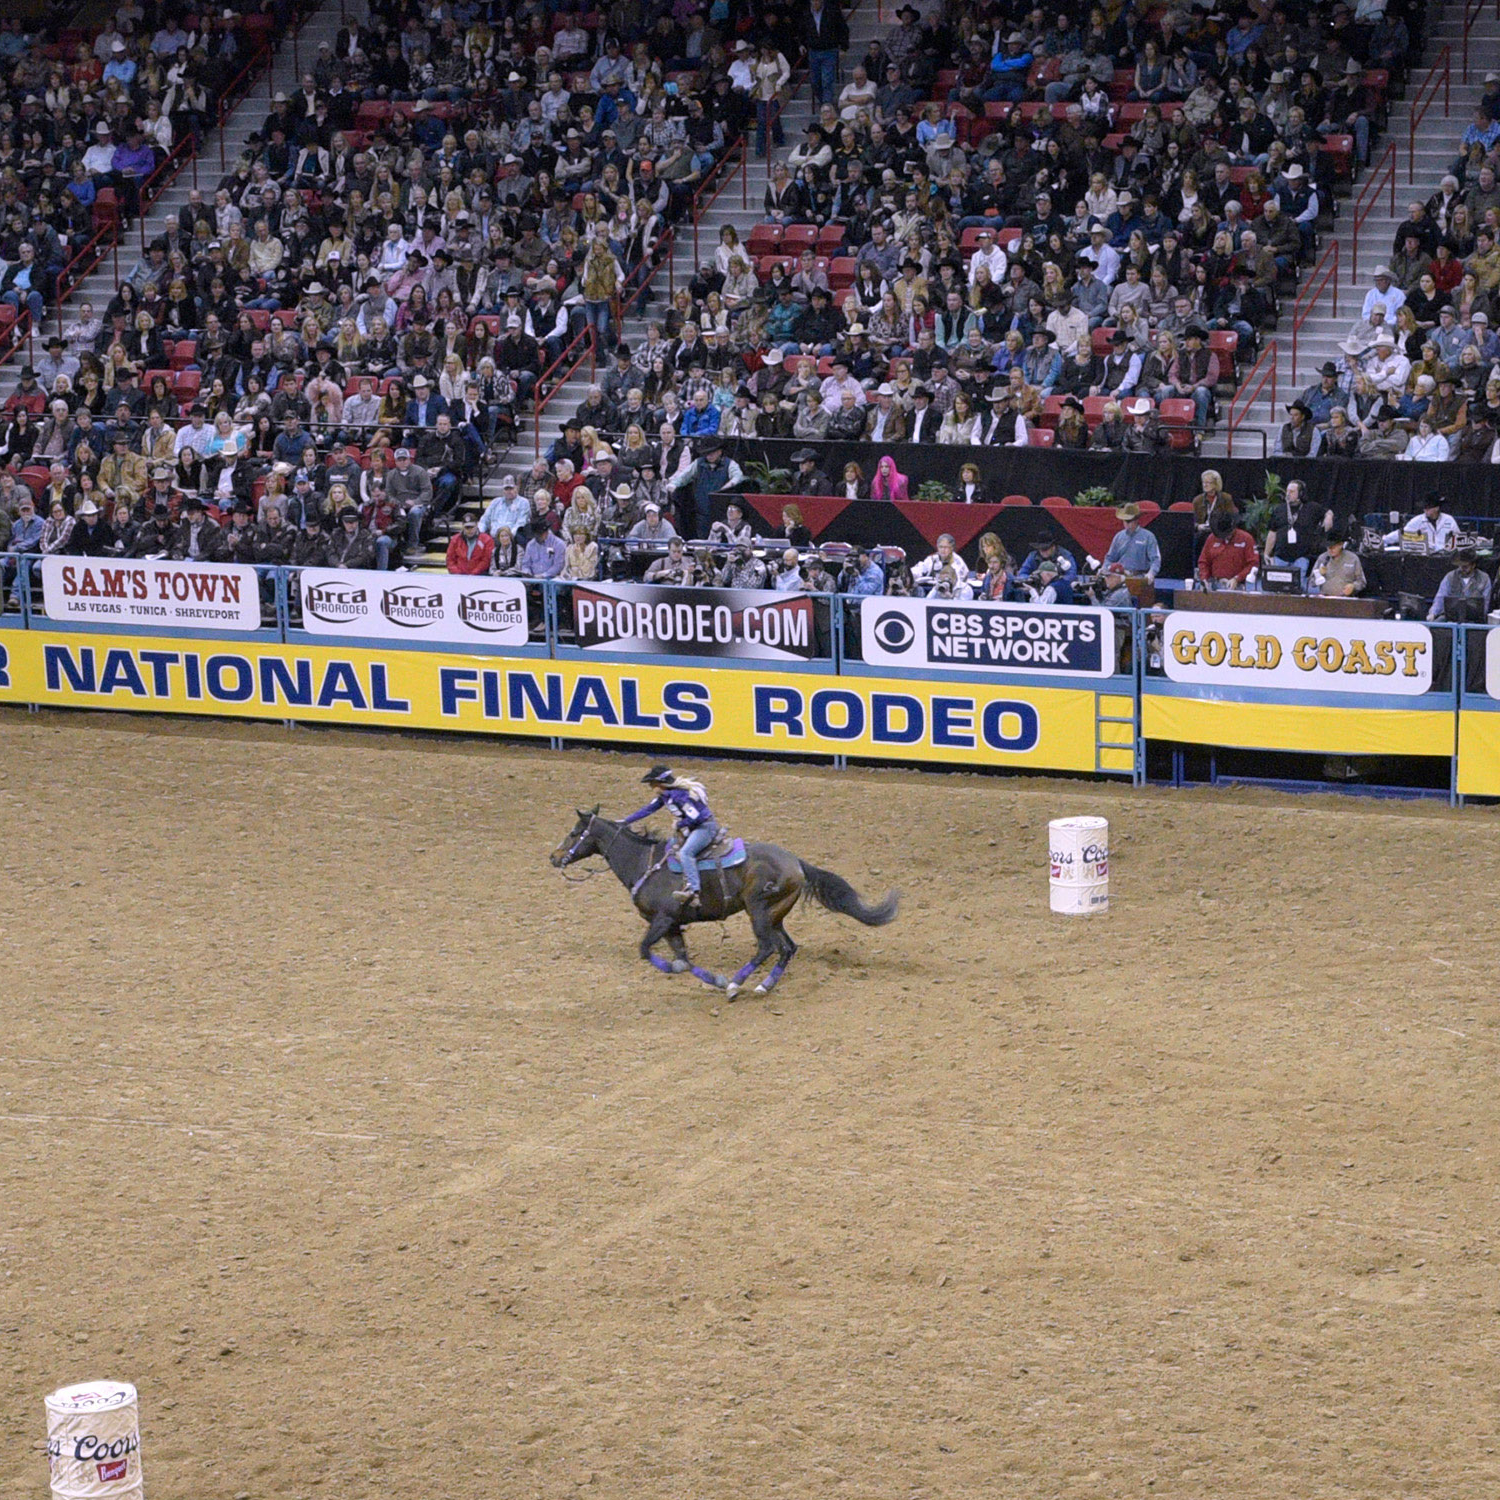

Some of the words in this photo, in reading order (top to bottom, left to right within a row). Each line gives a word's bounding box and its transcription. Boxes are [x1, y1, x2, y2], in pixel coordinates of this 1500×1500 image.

[62, 566, 147, 600] SAM'S
[155, 572, 241, 603] TOWN
[68, 602, 86, 612] LAS
[89, 603, 121, 613] VEGAS
[129, 605, 167, 616] TUNICA
[175, 608, 241, 620] SHREVEPORT
[307, 585, 367, 612] prca
[315, 603, 368, 615] PRORODEO
[383, 589, 443, 616] prca
[460, 593, 521, 620] prca
[390, 607, 444, 619] PRORODEO
[468, 611, 522, 624] PRORODEO
[577, 598, 808, 647] PRORODEO.COM
[931, 612, 984, 637] CBS
[989, 614, 1096, 642] SPORTS
[932, 635, 1069, 663] NETWORK
[1171, 629, 1282, 669] GOLD
[1292, 636, 1427, 676] COAST
[43, 644, 410, 713] NATIONAL
[439, 666, 712, 733] FINALS
[753, 684, 1039, 754] RODEO
[73, 1432, 139, 1461] Coors
